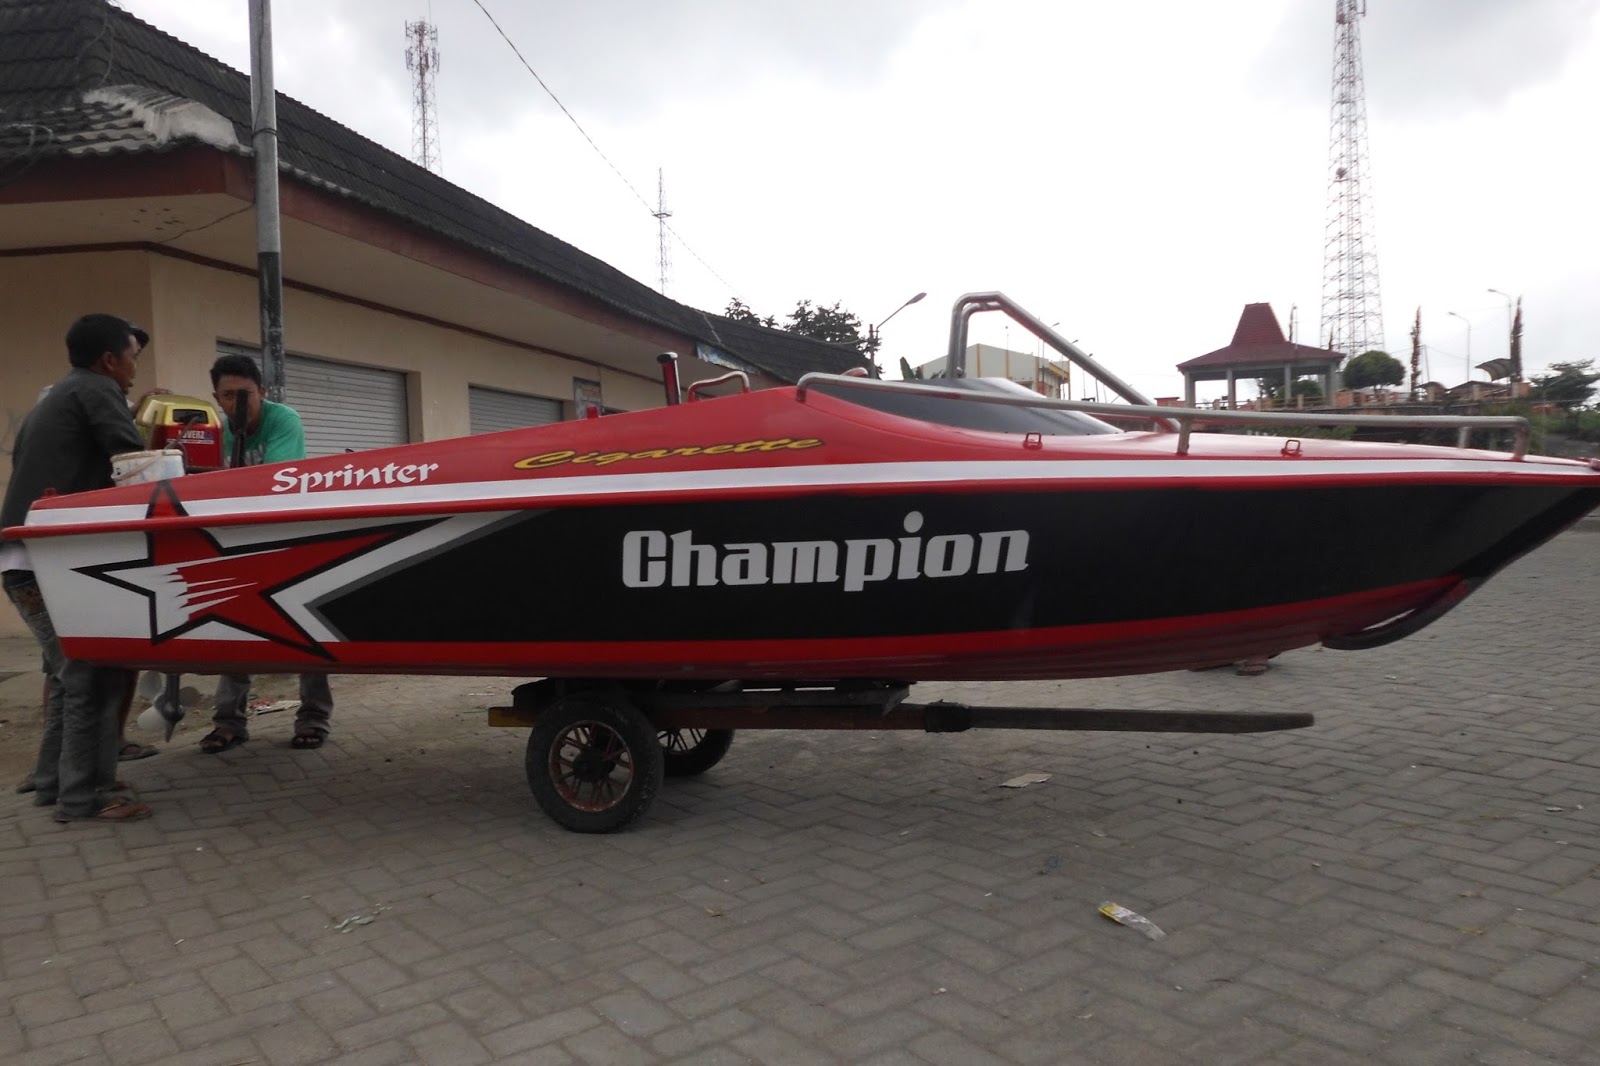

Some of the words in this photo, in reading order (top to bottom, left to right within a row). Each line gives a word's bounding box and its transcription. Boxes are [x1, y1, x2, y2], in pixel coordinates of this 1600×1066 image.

[512, 437, 824, 470] Cigarette
[271, 462, 439, 493] Sprinter
[622, 510, 1030, 592] Champion
